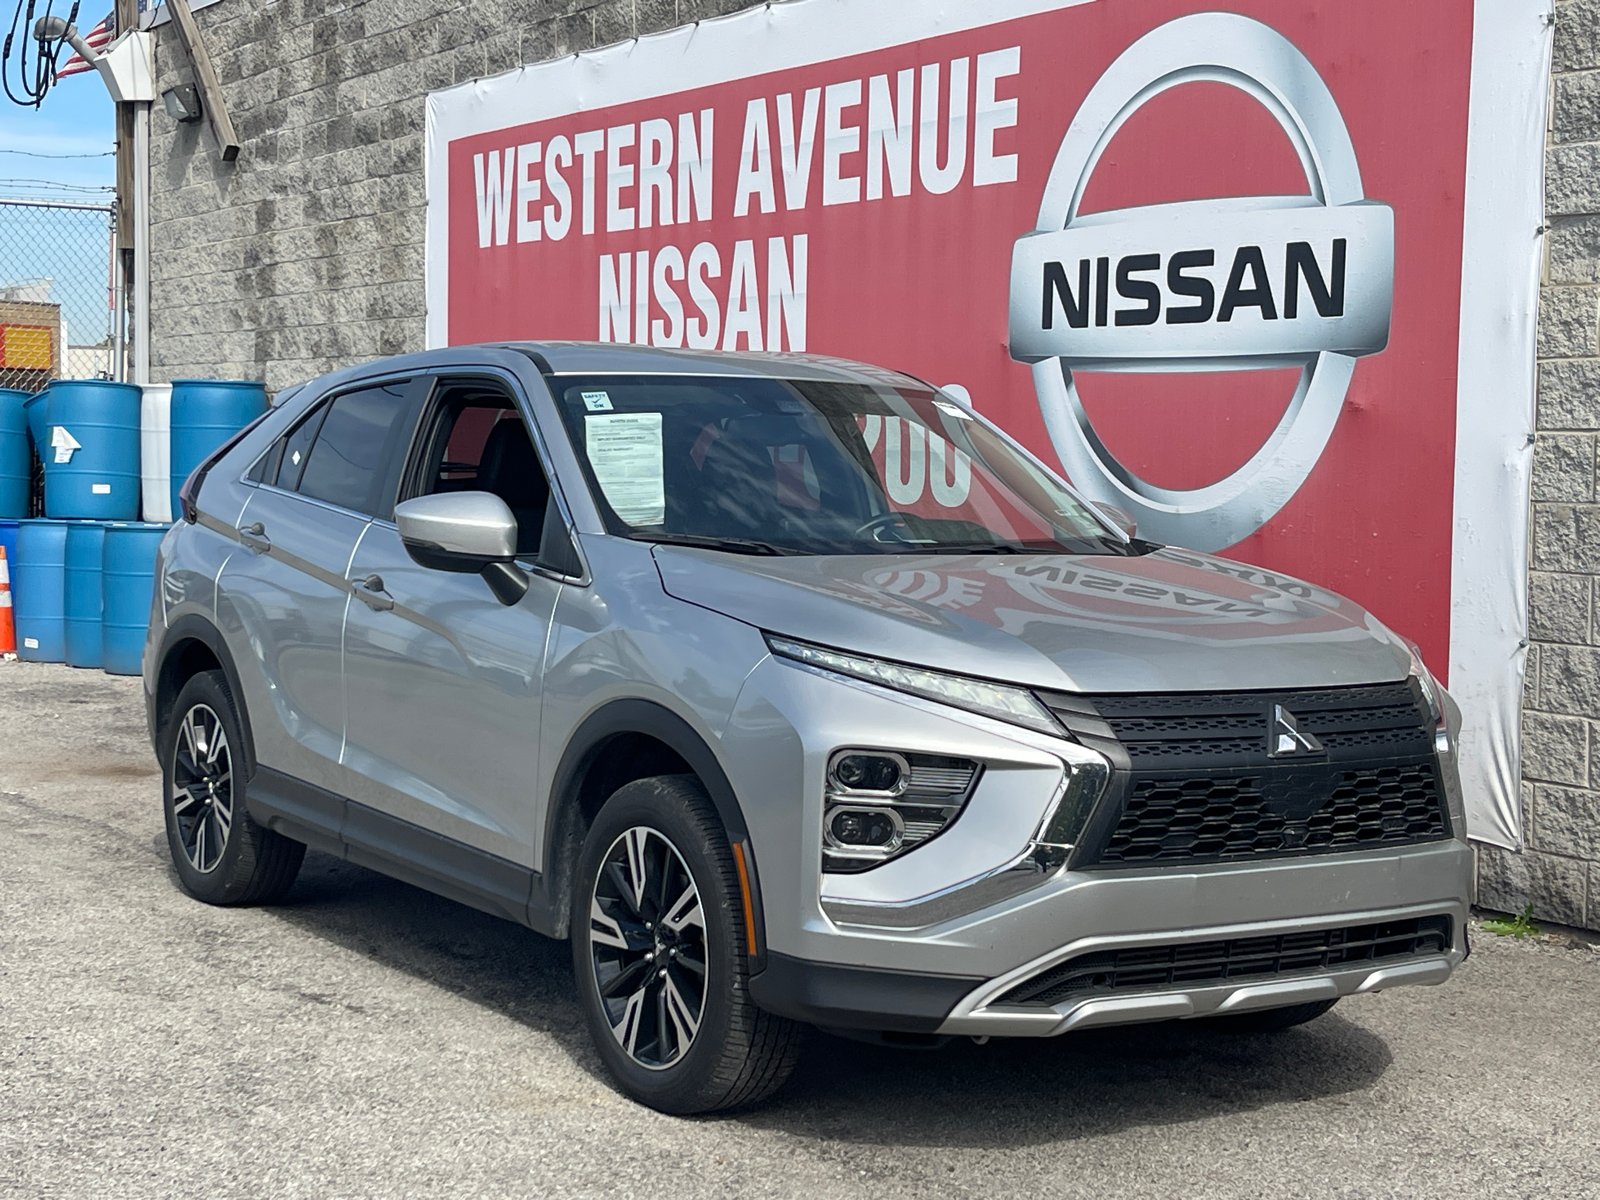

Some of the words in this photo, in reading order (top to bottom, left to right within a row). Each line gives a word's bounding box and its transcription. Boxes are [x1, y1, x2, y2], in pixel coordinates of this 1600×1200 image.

[473, 107, 714, 248] WESTERN
[733, 45, 1021, 217] AVENUE
[600, 233, 808, 352] NISSAN
[1041, 238, 1347, 330] NISSAN
